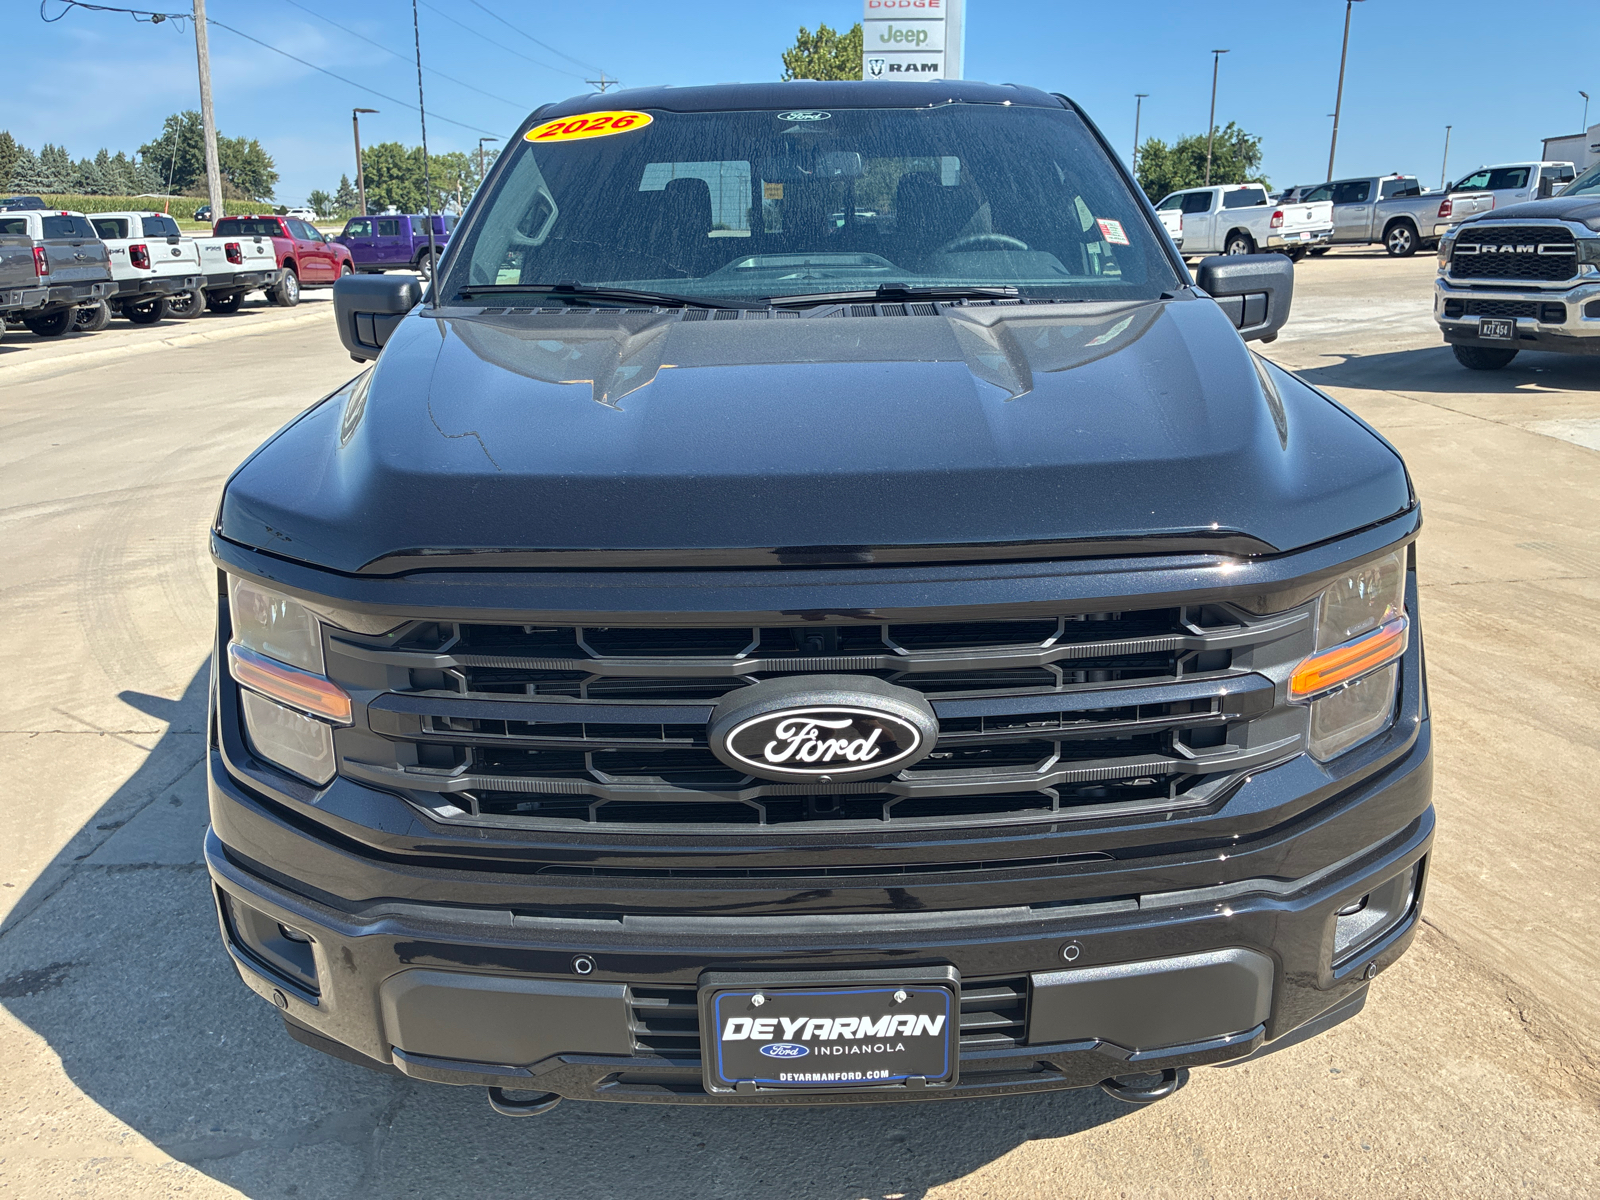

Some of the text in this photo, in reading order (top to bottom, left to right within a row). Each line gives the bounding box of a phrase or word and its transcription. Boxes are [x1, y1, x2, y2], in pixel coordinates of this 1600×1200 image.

[880, 25, 928, 47] Jeep
[889, 63, 939, 72] RAM
[787, 112, 822, 120] Ford
[535, 115, 639, 139] 2026
[1481, 244, 1534, 253] RAM
[764, 718, 882, 762] Ford
[722, 1015, 945, 1041] DEYARMAN
[770, 1043, 905, 1056] Ford INDIANOLA
[780, 1070, 889, 1081] DEYARMANFORD.COM
